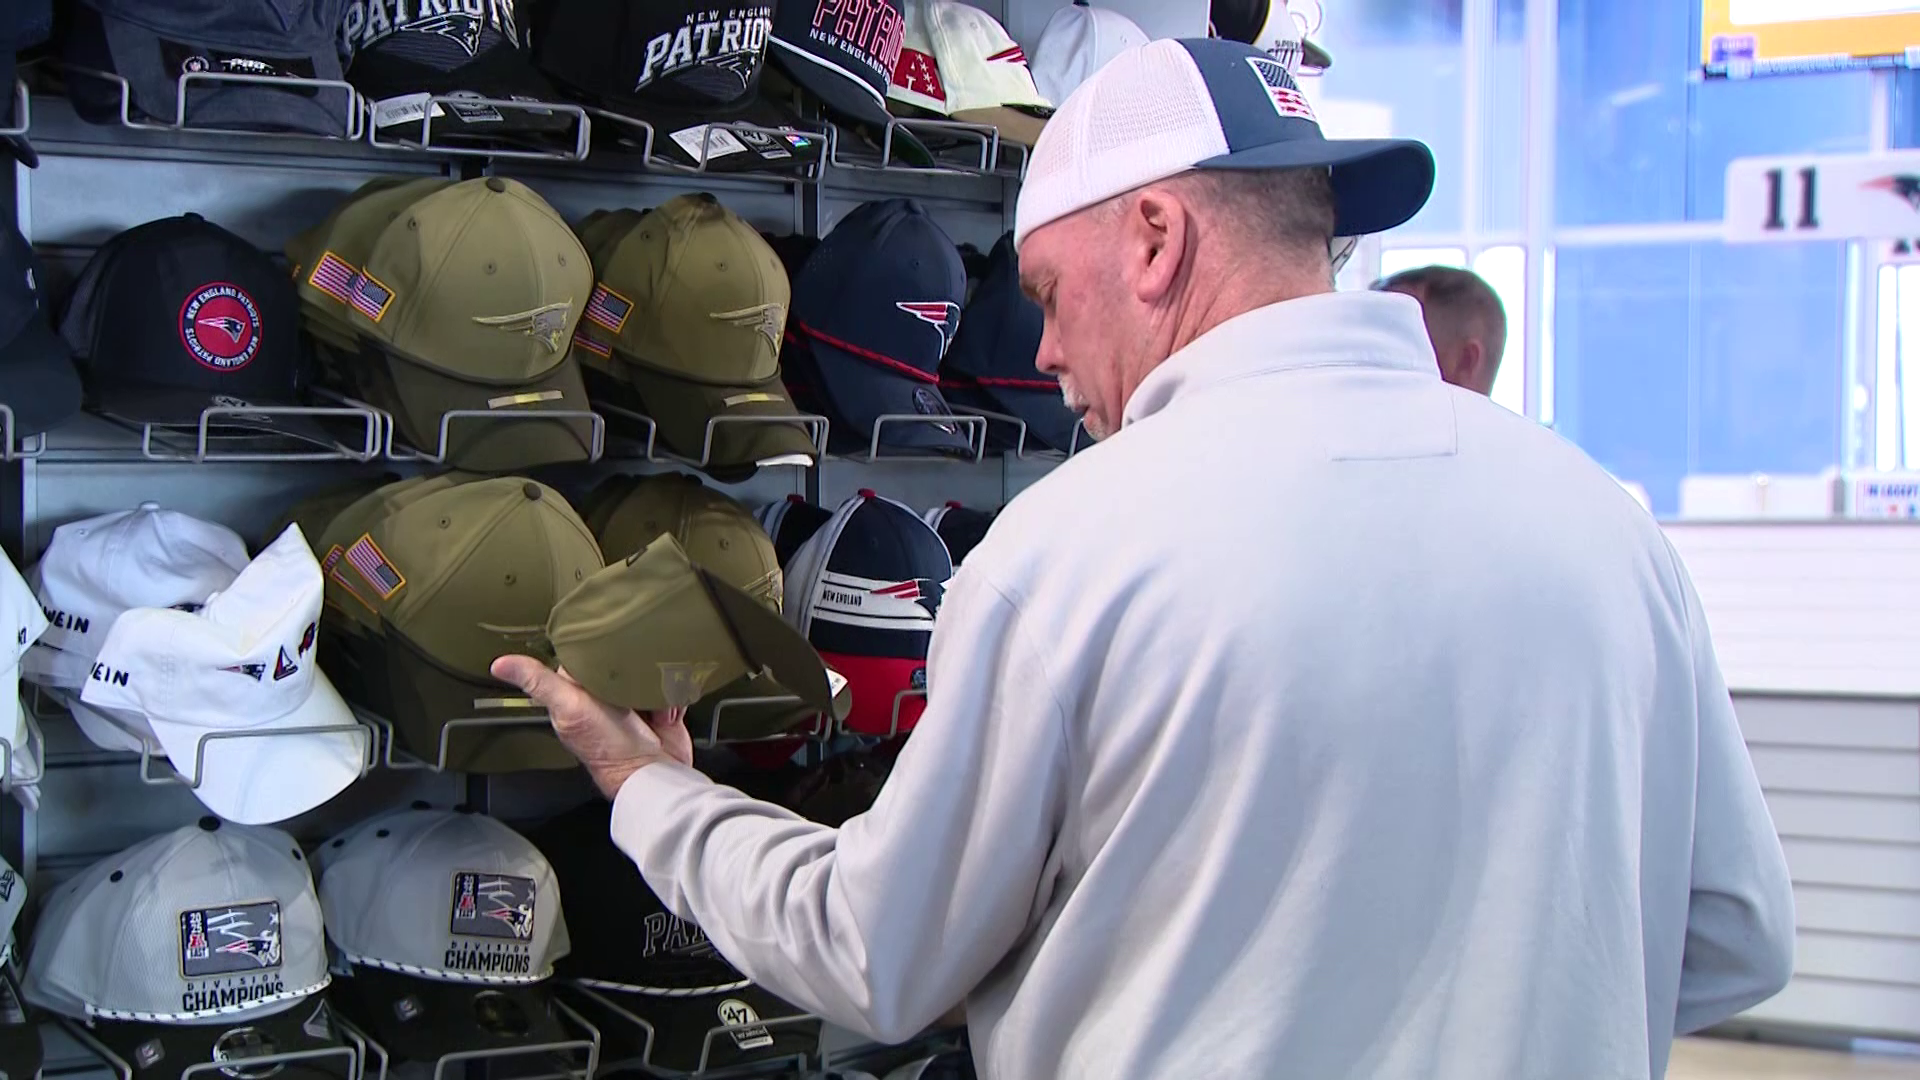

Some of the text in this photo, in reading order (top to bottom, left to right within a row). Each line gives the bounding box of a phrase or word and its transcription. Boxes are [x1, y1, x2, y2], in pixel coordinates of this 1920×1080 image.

[686, 6, 771, 25] NEW ENGLAN
[809, 28, 838, 46] NEW
[840, 41, 887, 76] ENGLAND
[1763, 167, 1819, 231] 11
[186, 286, 260, 328] NEW ENGLAND PATRIOTS
[822, 589, 862, 607] NEW ENGLAND
[444, 949, 530, 973] CHAMPIONS
[187, 973, 280, 991] DIVISION
[182, 981, 284, 1012] CHAMPIONS
